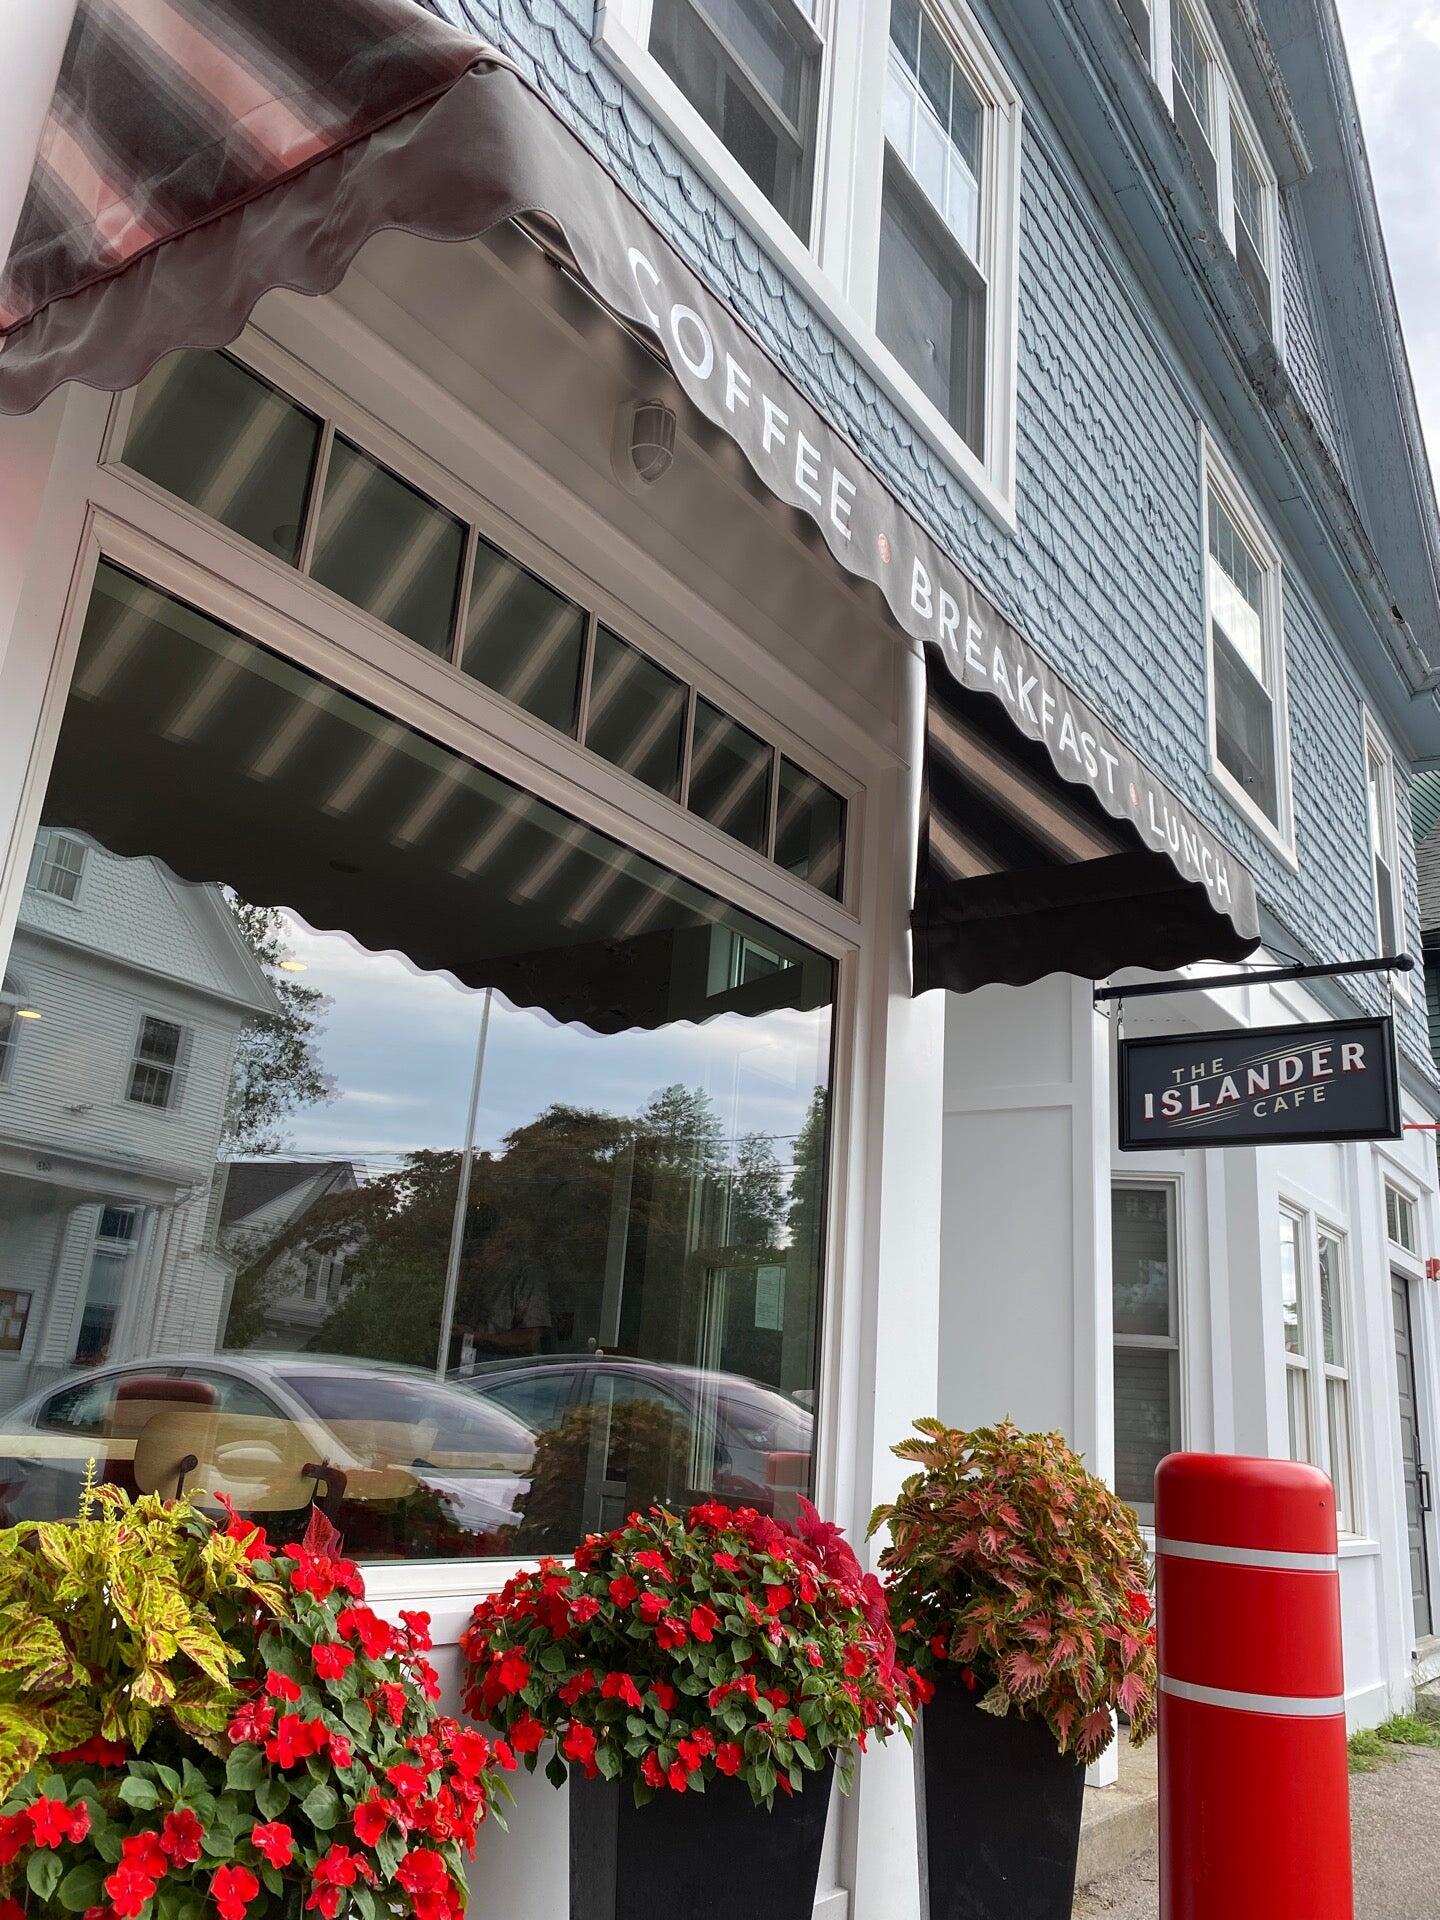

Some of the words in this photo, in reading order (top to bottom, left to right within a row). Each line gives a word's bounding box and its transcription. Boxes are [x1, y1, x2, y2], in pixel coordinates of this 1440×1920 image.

[628, 247, 856, 541] COFFEE
[911, 556, 1118, 795] BREAKFAST
[1149, 792, 1232, 903] LUNCH
[1144, 1042, 1366, 1119] ISLANDER
[1172, 1058, 1224, 1082] THE
[1253, 1086, 1326, 1118] CAFE
